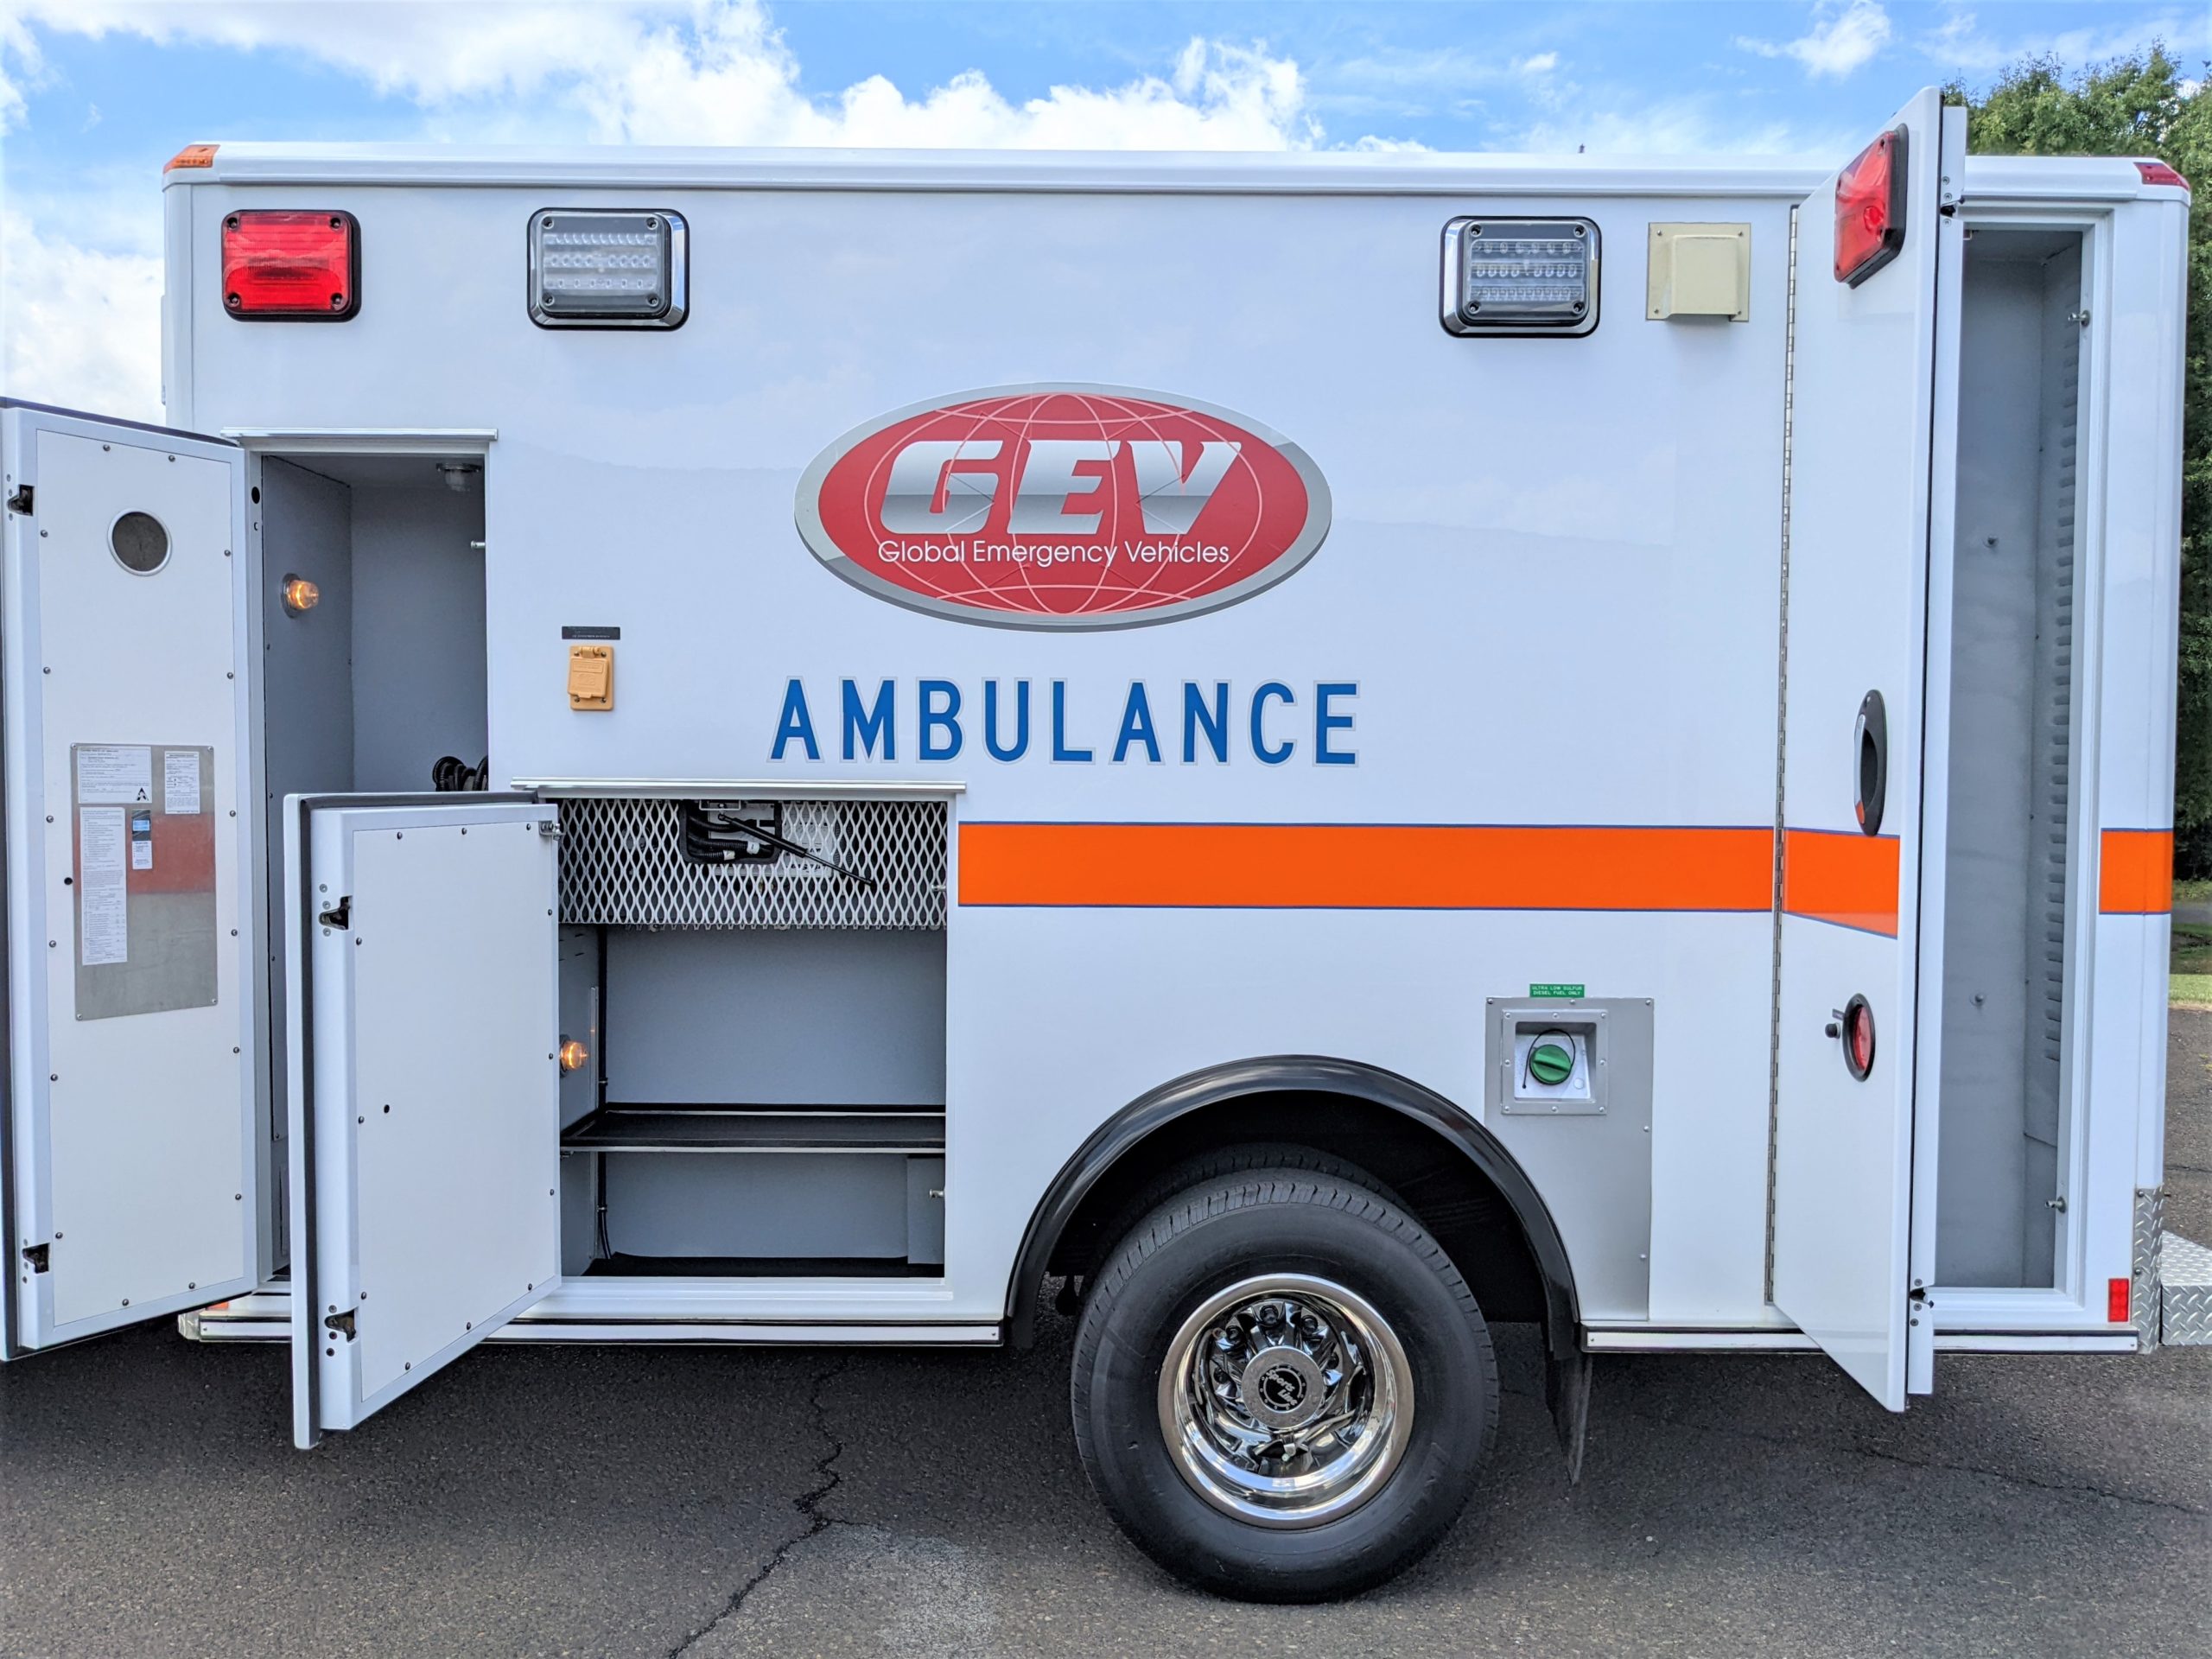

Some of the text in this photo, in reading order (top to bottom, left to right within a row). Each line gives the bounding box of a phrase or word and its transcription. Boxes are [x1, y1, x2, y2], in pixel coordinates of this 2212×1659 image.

[880, 440, 1242, 534] GEV
[878, 540, 1230, 567] Global Emergency Vehicles
[768, 677, 1359, 766] AMBULANCE
[1266, 1370, 1295, 1392] Sports
[1277, 1389, 1298, 1406] Line
